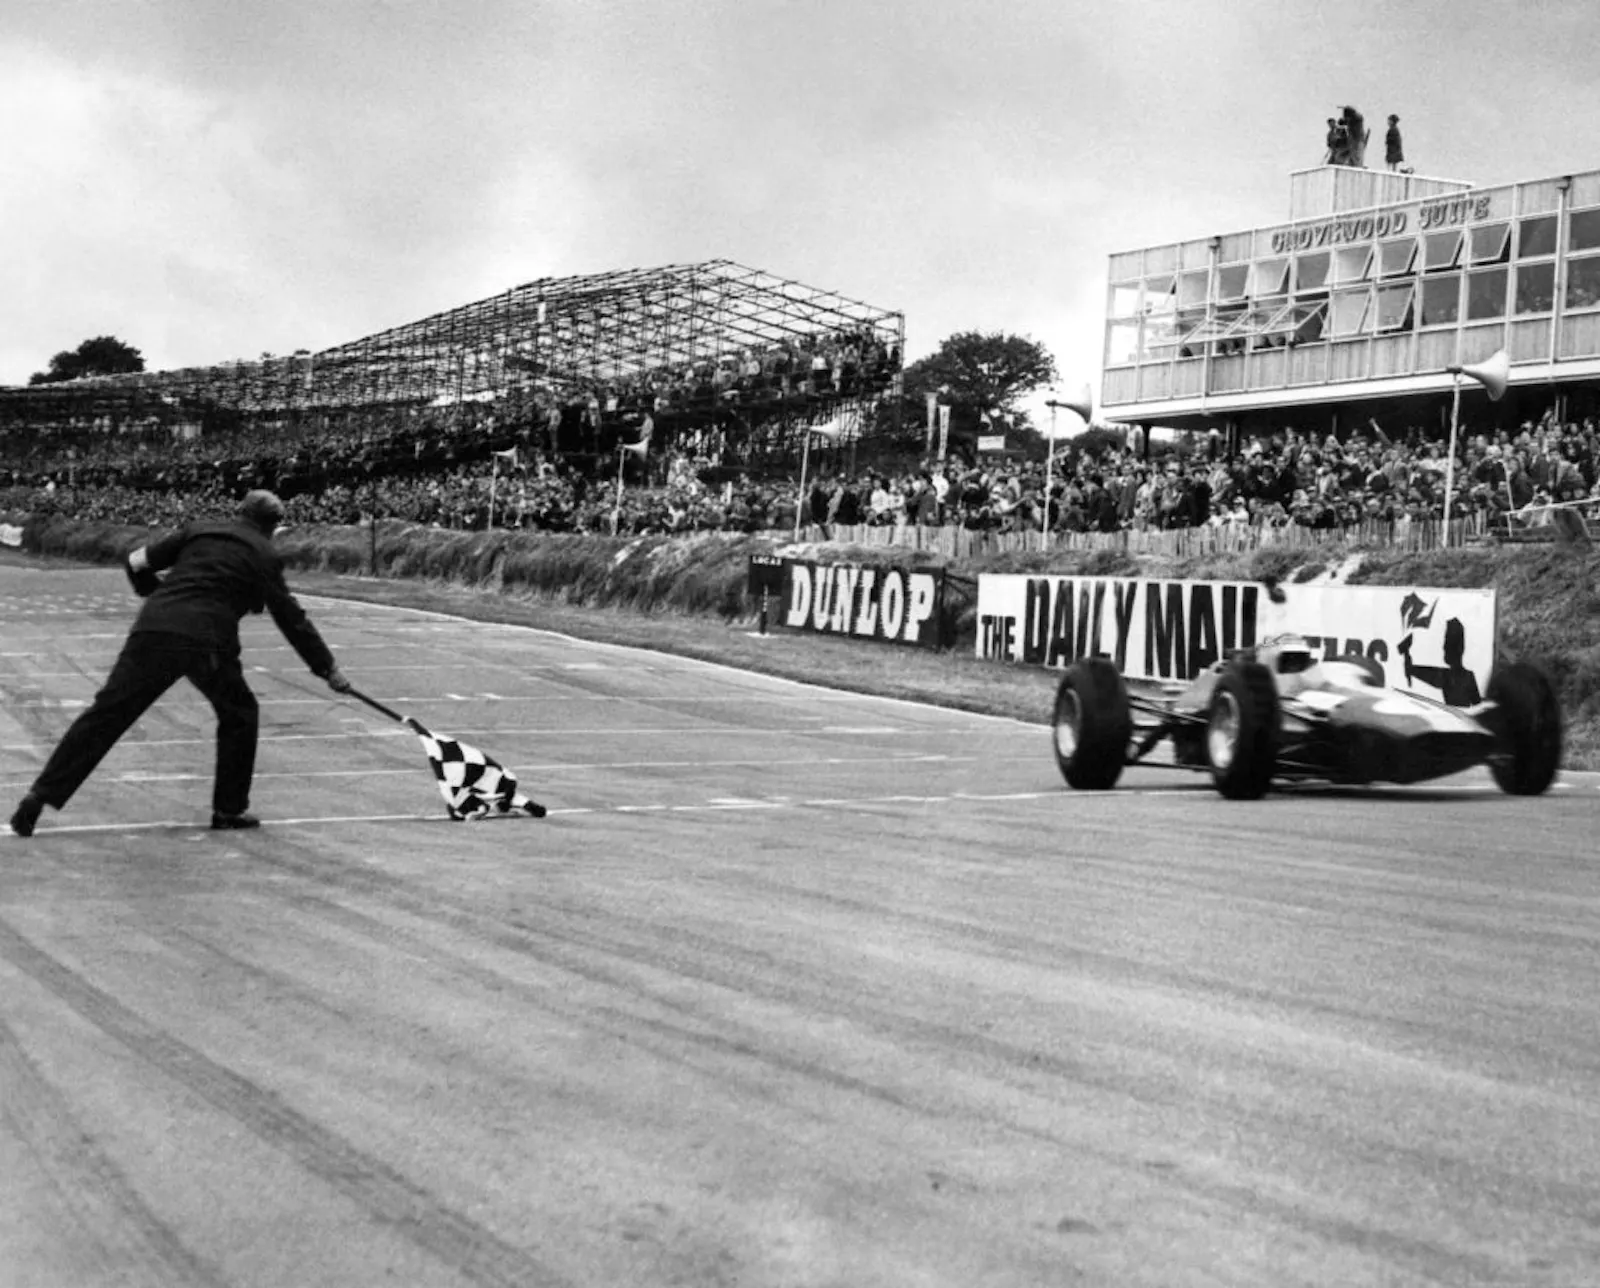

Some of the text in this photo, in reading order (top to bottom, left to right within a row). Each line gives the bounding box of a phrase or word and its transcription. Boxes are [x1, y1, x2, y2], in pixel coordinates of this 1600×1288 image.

[786, 564, 936, 642] DUNLOP
[981, 614, 1016, 662] THE
[1023, 578, 1138, 676] DAILY
